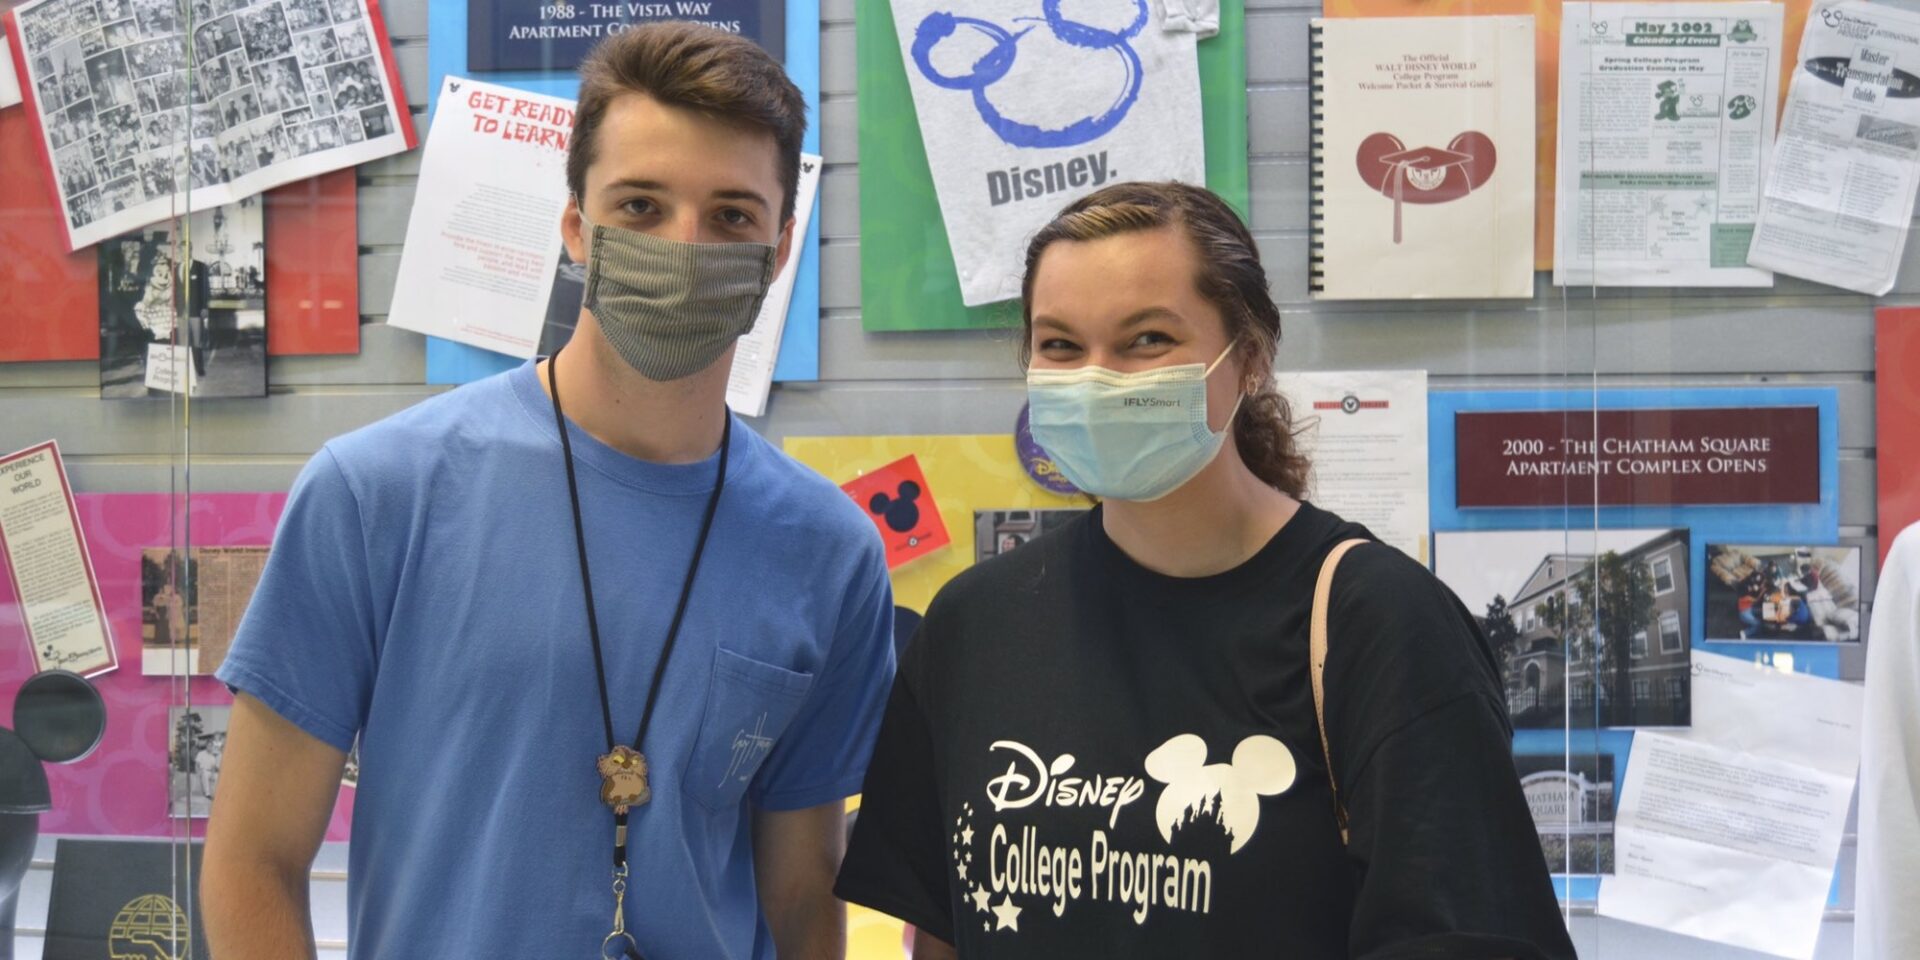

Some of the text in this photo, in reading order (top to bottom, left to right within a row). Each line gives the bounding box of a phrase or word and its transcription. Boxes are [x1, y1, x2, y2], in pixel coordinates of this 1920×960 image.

[539, 5, 575, 20] 1988
[590, 4, 623, 18] THE
[628, 3, 673, 17] VISTA
[676, 1, 712, 16] WAY
[509, 24, 602, 39] APARTMENT
[1635, 22, 1713, 35] May 2002
[1632, 36, 1674, 45] Calendar
[1676, 36, 1686, 45] of
[1687, 36, 1718, 45] Events
[1419, 54, 1450, 62] Official
[1633, 57, 1661, 67] College
[1664, 57, 1700, 67] Program
[1861, 48, 1889, 66] Master
[1376, 62, 1477, 72] WALT DISNEY WORLD
[1393, 72, 1459, 82] College Program
[1358, 82, 1393, 91] Welcome
[1397, 81, 1422, 90] Packet
[1434, 80, 1467, 90] Survival
[1470, 79, 1493, 89] Guide
[467, 91, 576, 129] GET READY
[473, 113, 499, 134] TO
[987, 151, 1118, 207] Disney.
[1502, 438, 1544, 456] 2000
[1560, 438, 1597, 455] THE
[1602, 437, 1695, 455] CHATHAM
[1700, 436, 1771, 456] SQUARE
[0, 453, 45, 476] XPERIENCE
[1506, 456, 1767, 476] APARTMENT COMPLEX OPENS
[14, 469, 33, 482] OUR
[11, 478, 42, 495] WORLD
[1528, 791, 1575, 803] HATHAM
[1531, 804, 1567, 816] QUARE
[990, 823, 1212, 925] College Program
